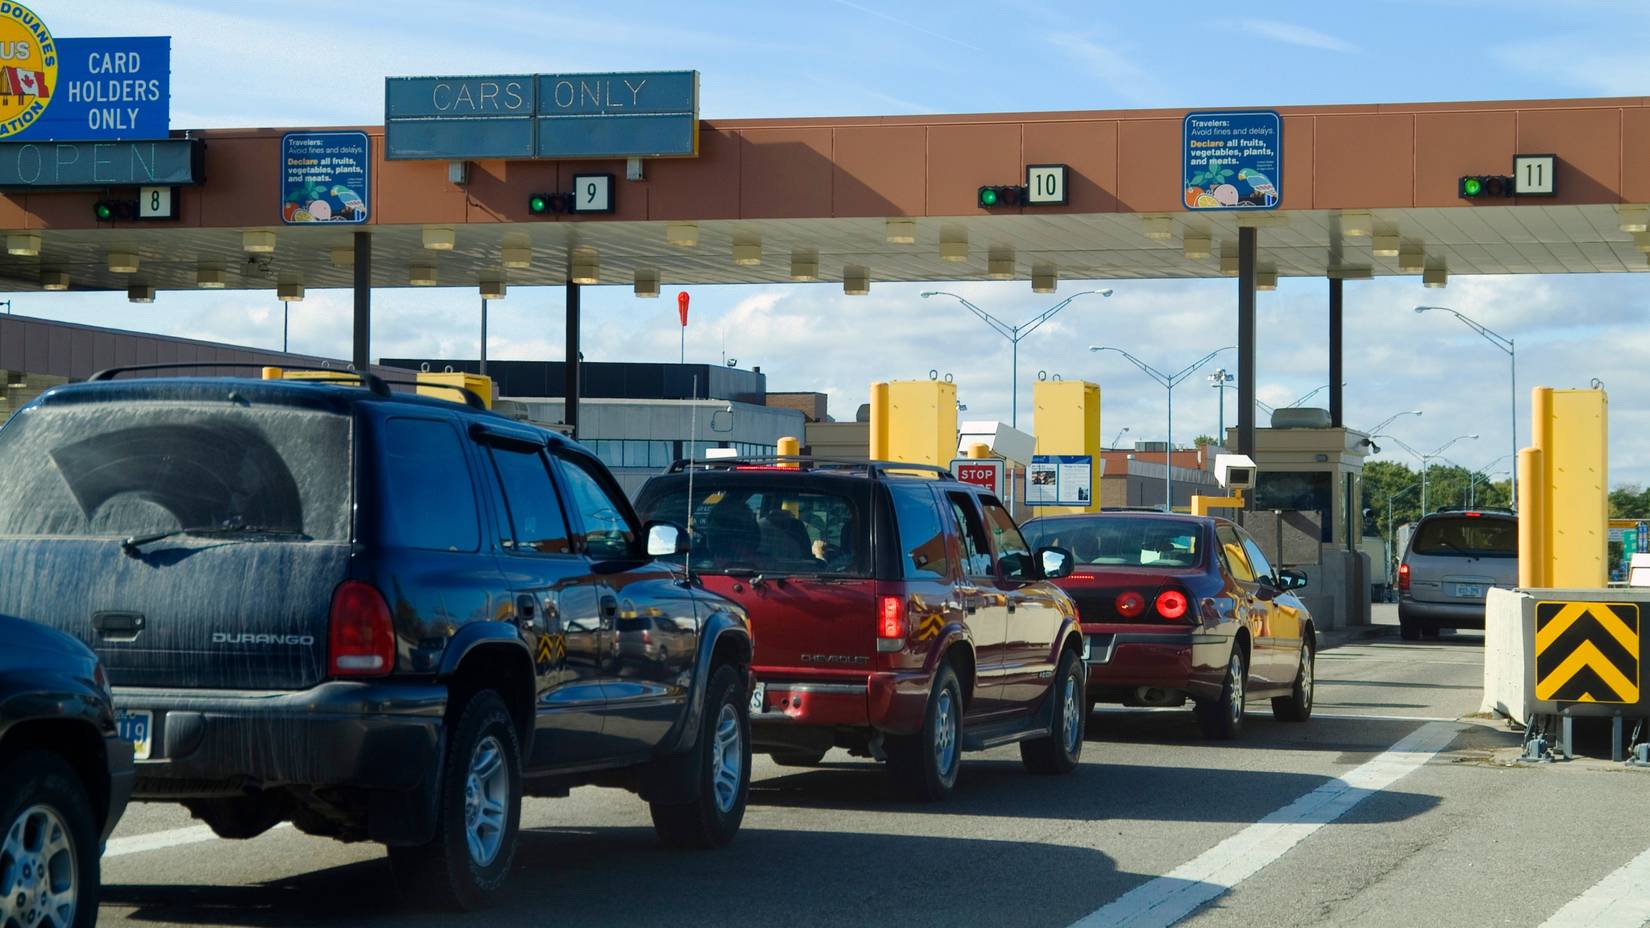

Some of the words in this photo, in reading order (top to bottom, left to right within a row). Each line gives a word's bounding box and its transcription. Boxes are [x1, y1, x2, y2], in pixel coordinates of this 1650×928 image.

[0, 2, 55, 67] DOUANES
[89, 52, 141, 74] CARD
[68, 80, 160, 103] HOLDERS
[433, 82, 522, 111] CARS
[555, 79, 647, 108] ONLY
[88, 108, 140, 130] ONLY
[1191, 119, 1230, 127] Travelers:
[1191, 128, 1212, 136] Avoid
[1214, 127, 1231, 135] fines
[1232, 127, 1247, 135] and
[1190, 139, 1225, 148] Declare
[1226, 139, 1238, 147] all
[1240, 138, 1267, 148] fruits,
[308, 146, 325, 154] fines
[326, 146, 339, 154] and
[1190, 148, 1242, 158] vegetables,
[1243, 148, 1274, 157] plants,
[17, 143, 156, 184] OPEN
[287, 158, 319, 166] Declare
[320, 157, 331, 165] all
[332, 157, 356, 166] fruits,
[1190, 157, 1207, 165] and
[1209, 157, 1240, 165] meats.
[288, 166, 334, 175] vegetables,
[335, 165, 363, 175] plants,
[1526, 163, 1542, 187] 11
[288, 175, 303, 183] and
[1036, 173, 1056, 196] 10
[587, 182, 597, 204] 9
[150, 190, 160, 211] 8
[961, 470, 993, 480] STOP
[212, 632, 315, 646] DURANGO
[801, 654, 870, 665] CHEVROLET
